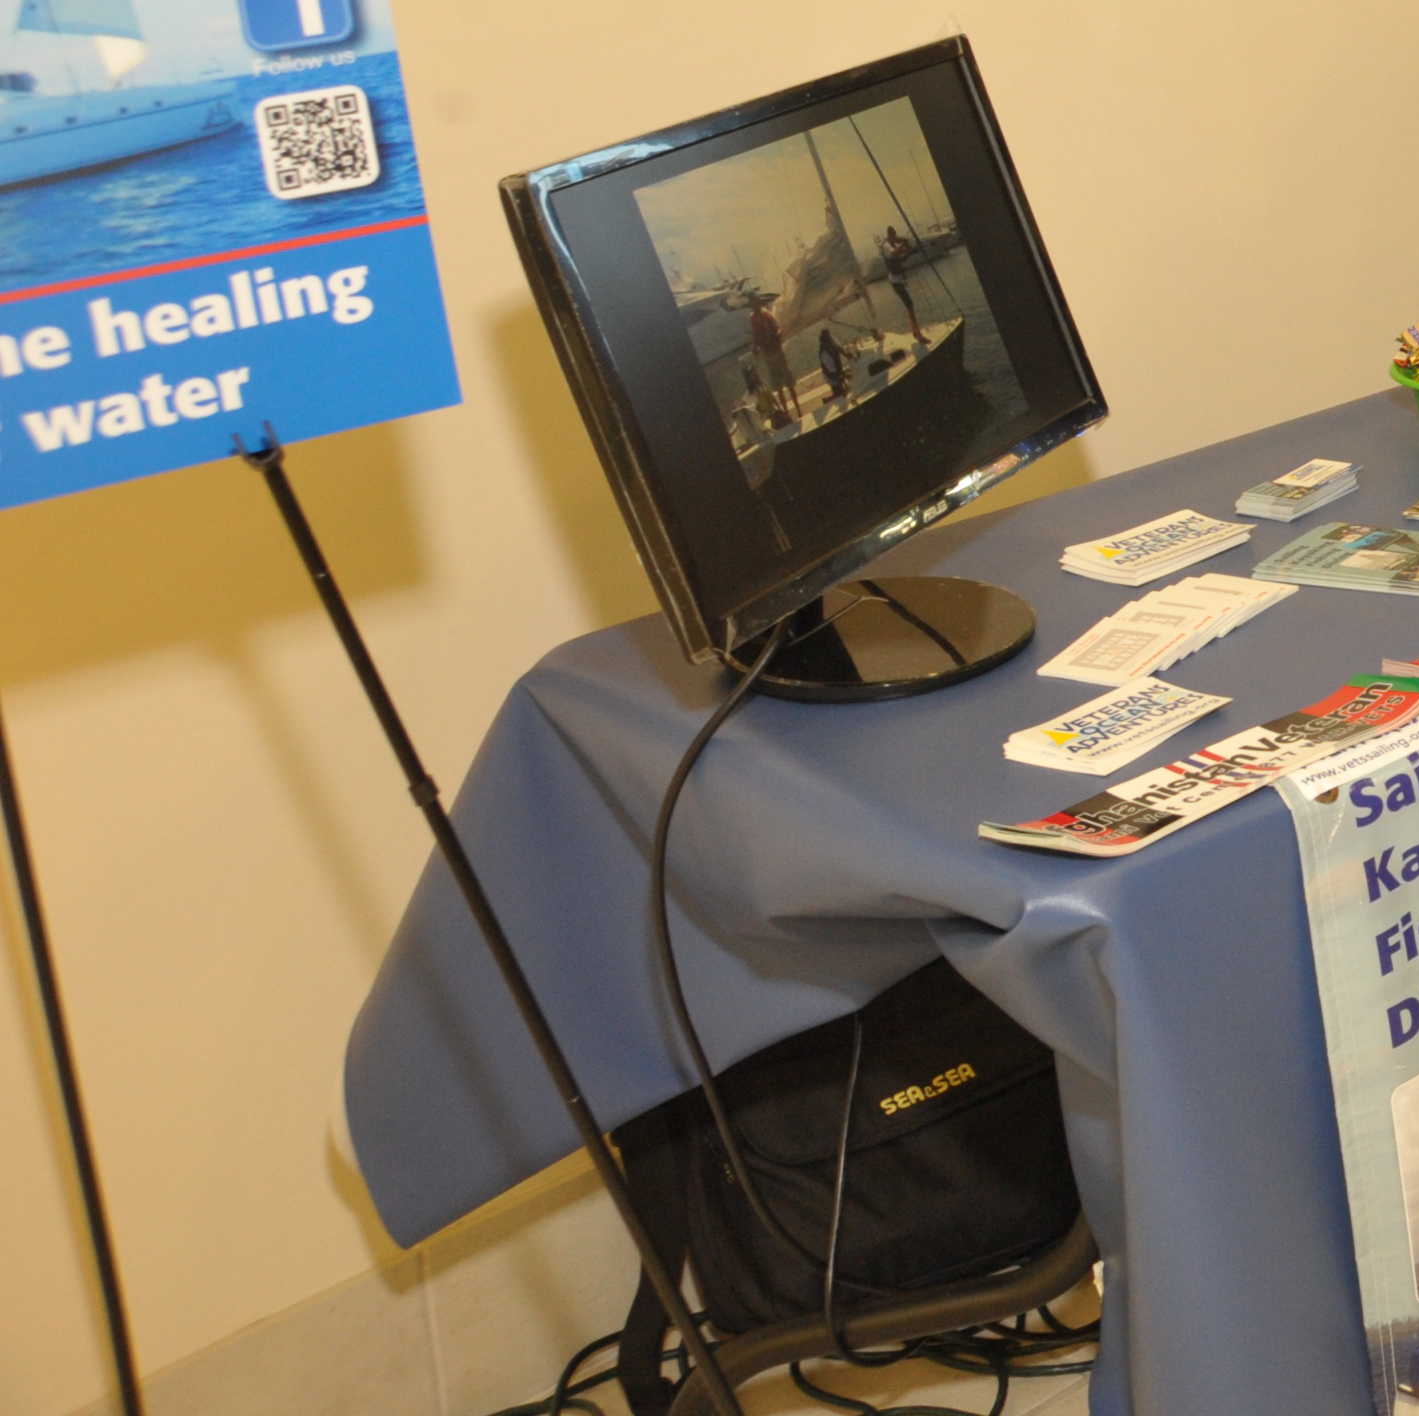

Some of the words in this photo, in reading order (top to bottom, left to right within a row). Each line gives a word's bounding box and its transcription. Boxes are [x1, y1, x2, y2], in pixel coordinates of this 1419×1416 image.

[253, 55, 324, 76] Follow
[329, 50, 355, 67] us
[87, 265, 374, 358] healing
[20, 365, 250, 453] water
[1104, 516, 1205, 550] VETERANS
[1114, 523, 1232, 565] ADVENTURES
[1126, 527, 1197, 553] OCEAN
[1055, 684, 1170, 733] VETERANS
[1067, 693, 1204, 754] ADVENTURES
[1080, 699, 1163, 736] OCEAN
[1240, 681, 1394, 754] Veteran
[1133, 804, 1182, 827] Vet
[1182, 766, 1257, 805] Center
[1257, 749, 1298, 769] 877
